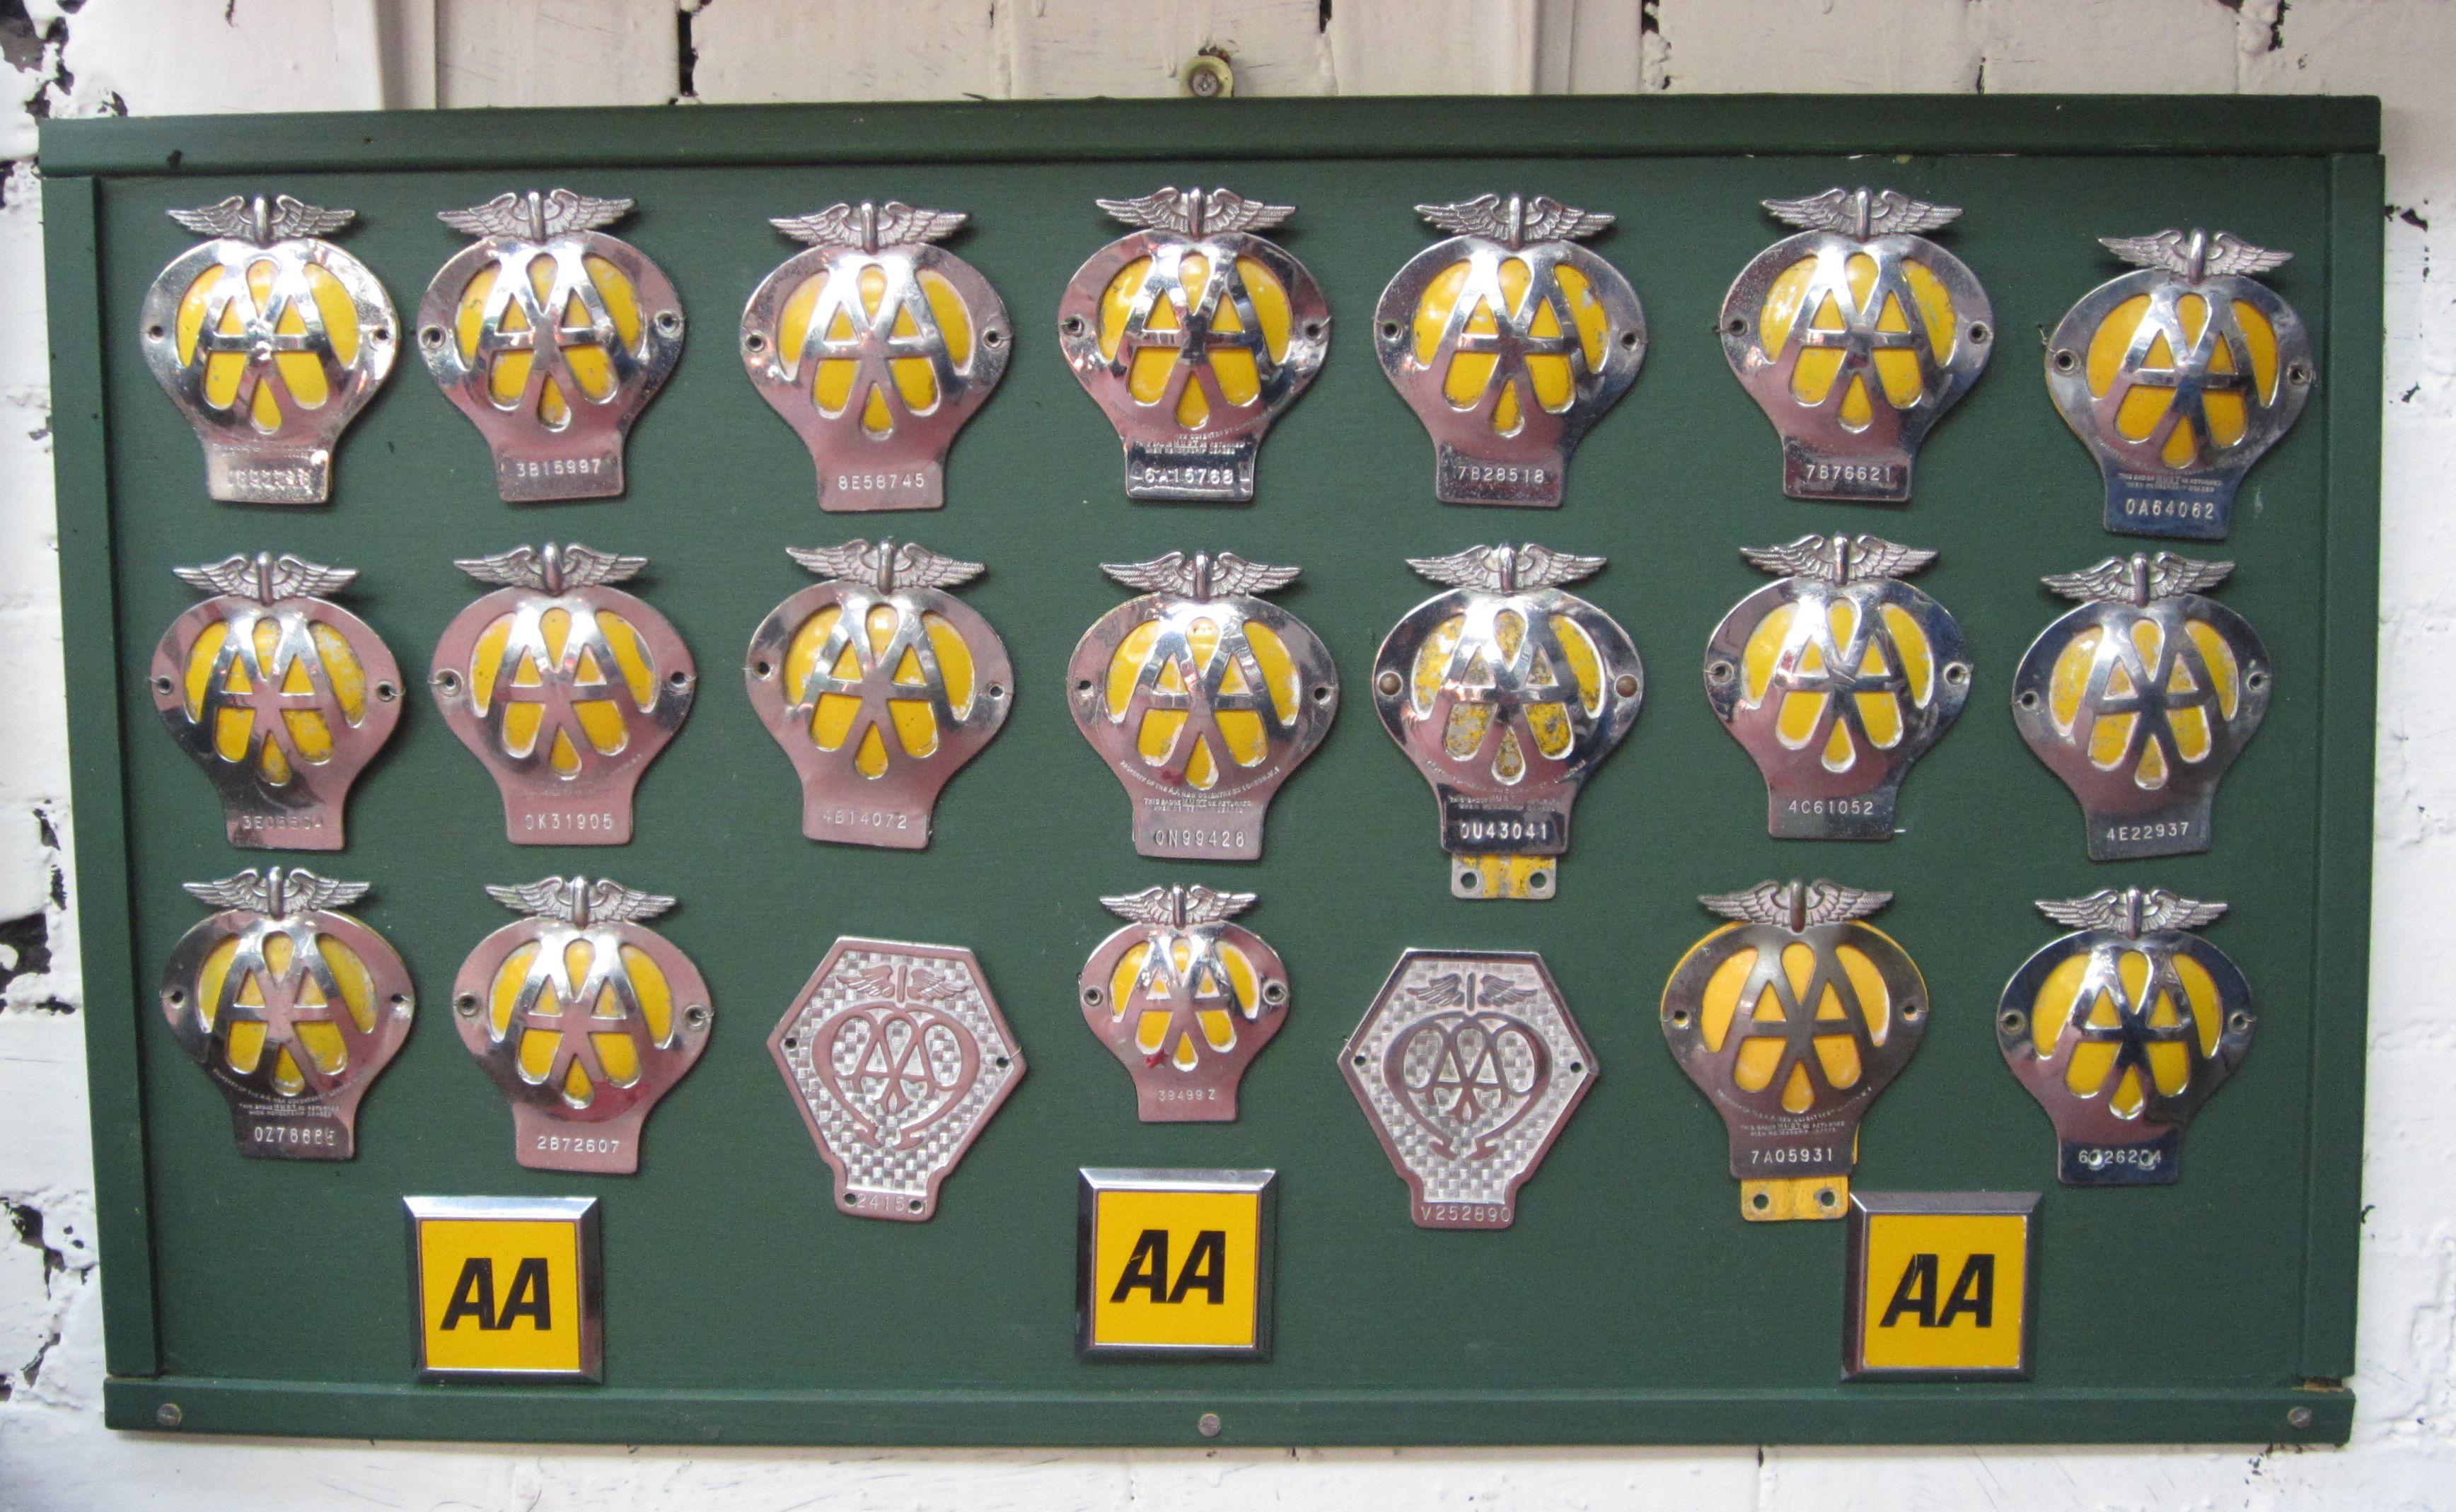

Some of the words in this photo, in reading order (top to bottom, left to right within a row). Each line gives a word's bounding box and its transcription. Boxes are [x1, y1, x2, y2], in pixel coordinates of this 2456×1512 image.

[186, 255, 348, 409] AA
[470, 253, 633, 410] AA
[795, 260, 958, 417] AA
[1113, 253, 1278, 407] AA
[1427, 257, 1594, 412] AA
[1773, 256, 1940, 407] AA
[2100, 293, 2261, 447] AA
[516, 458, 601, 477] 3B15997
[838, 472, 925, 490] 8E58745
[1459, 465, 1544, 483] 7B28518
[1807, 464, 1892, 482] 7B76621
[199, 617, 351, 764] AA
[485, 608, 643, 757] AA
[799, 603, 956, 757] AA
[1123, 617, 1285, 766] AA
[1427, 608, 1589, 759] AA
[1761, 599, 1920, 748] AA
[2071, 617, 2226, 771] AA
[823, 810, 908, 829] 4B14072
[1788, 800, 1874, 815] 4C61052
[2106, 821, 2189, 841] 4E22937
[210, 931, 366, 1074] AA
[503, 939, 654, 1088] AA
[1120, 938, 1248, 1054] AA
[1718, 943, 1877, 1091] AA
[2050, 950, 2213, 1098] AA
[537, 1135, 620, 1153] 2B72607
[1420, 1205, 1511, 1223] V252890
[1751, 1147, 1833, 1165] 7A05931
[2078, 1148, 2162, 1165] 62624
[439, 1257, 552, 1330] AA
[1109, 1229, 1226, 1305] AA
[1879, 1253, 1996, 1327] AA
